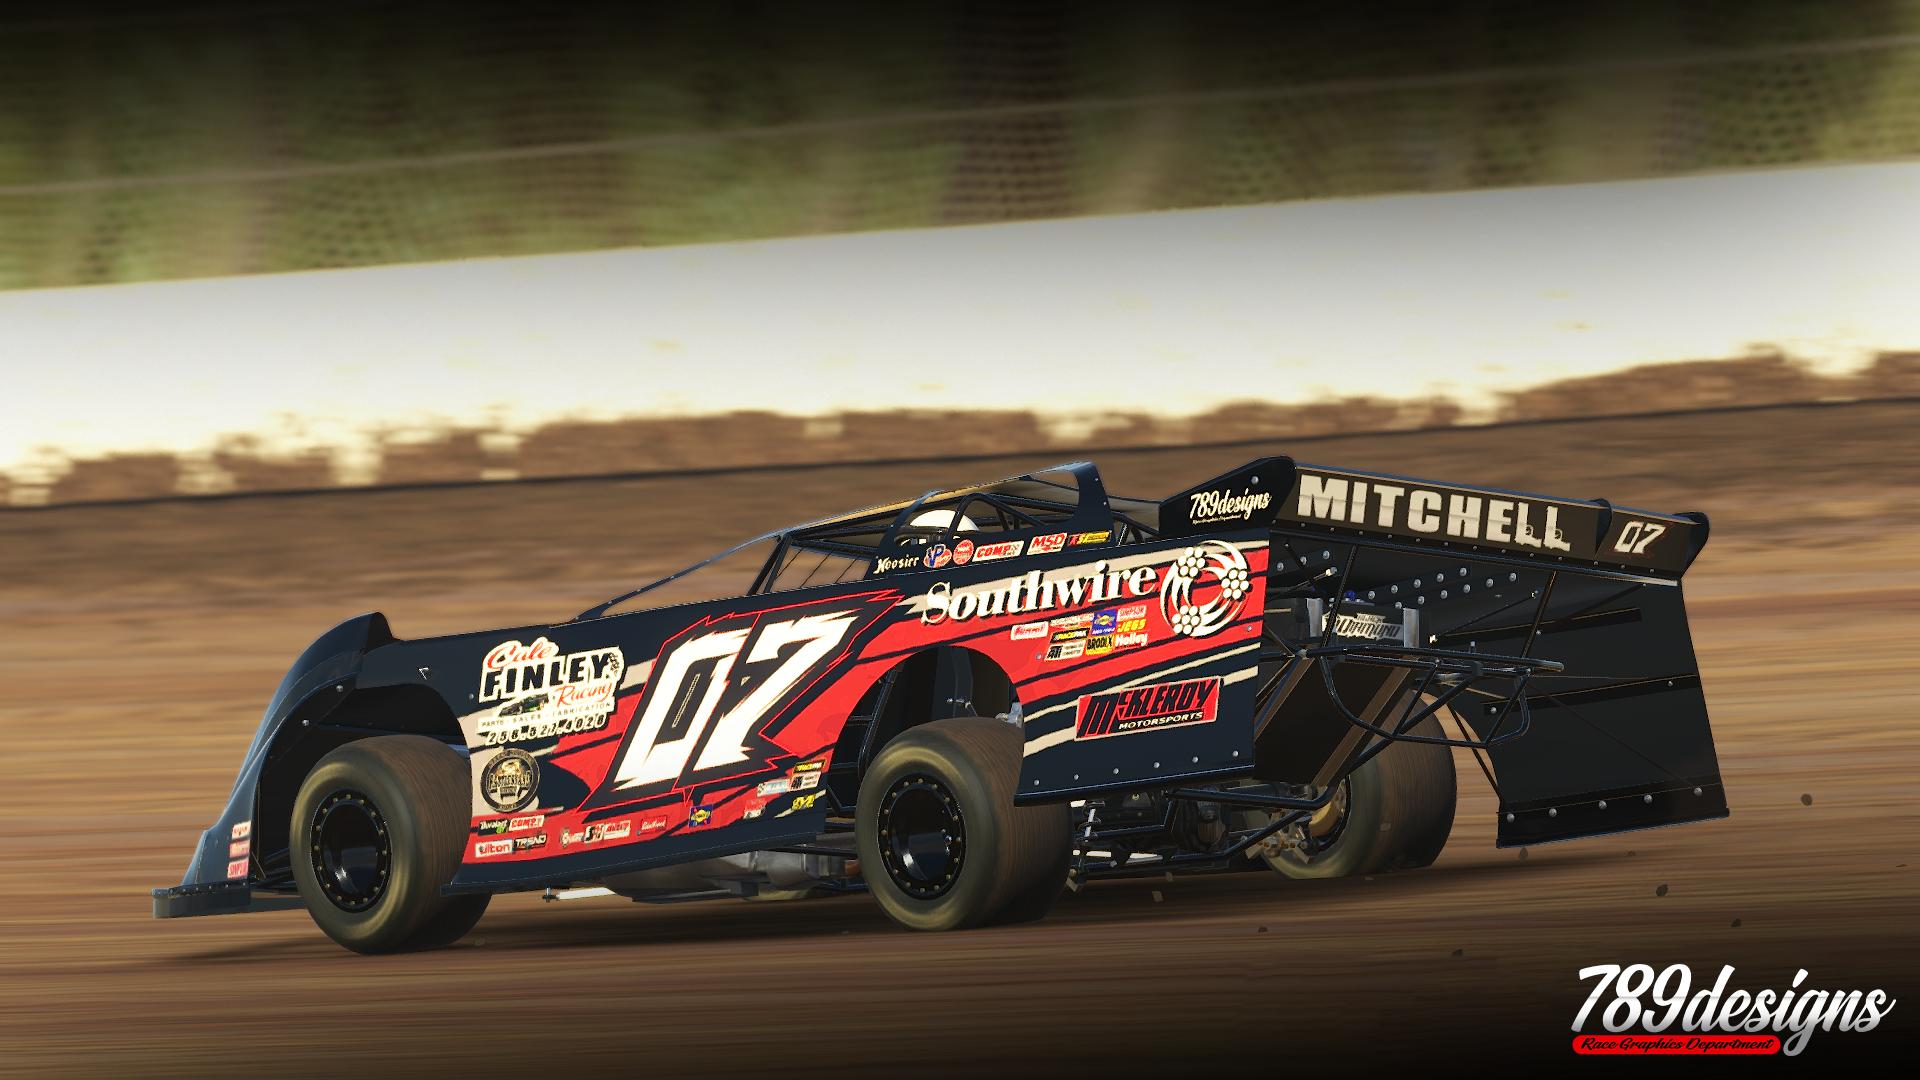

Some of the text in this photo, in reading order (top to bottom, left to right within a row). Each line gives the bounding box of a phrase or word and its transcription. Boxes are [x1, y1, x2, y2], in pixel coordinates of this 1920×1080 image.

[1190, 488, 1272, 520] 789designs
[1298, 473, 1570, 552] MITCHELL
[1032, 533, 1065, 548] MSD
[1614, 520, 1667, 555] 07
[920, 560, 1157, 624] Southwire
[487, 641, 551, 669] Cale
[484, 652, 611, 698] FINLEY
[554, 682, 613, 708] Racing
[612, 608, 862, 793] 07
[1118, 711, 1204, 730] MOTORSPORTS
